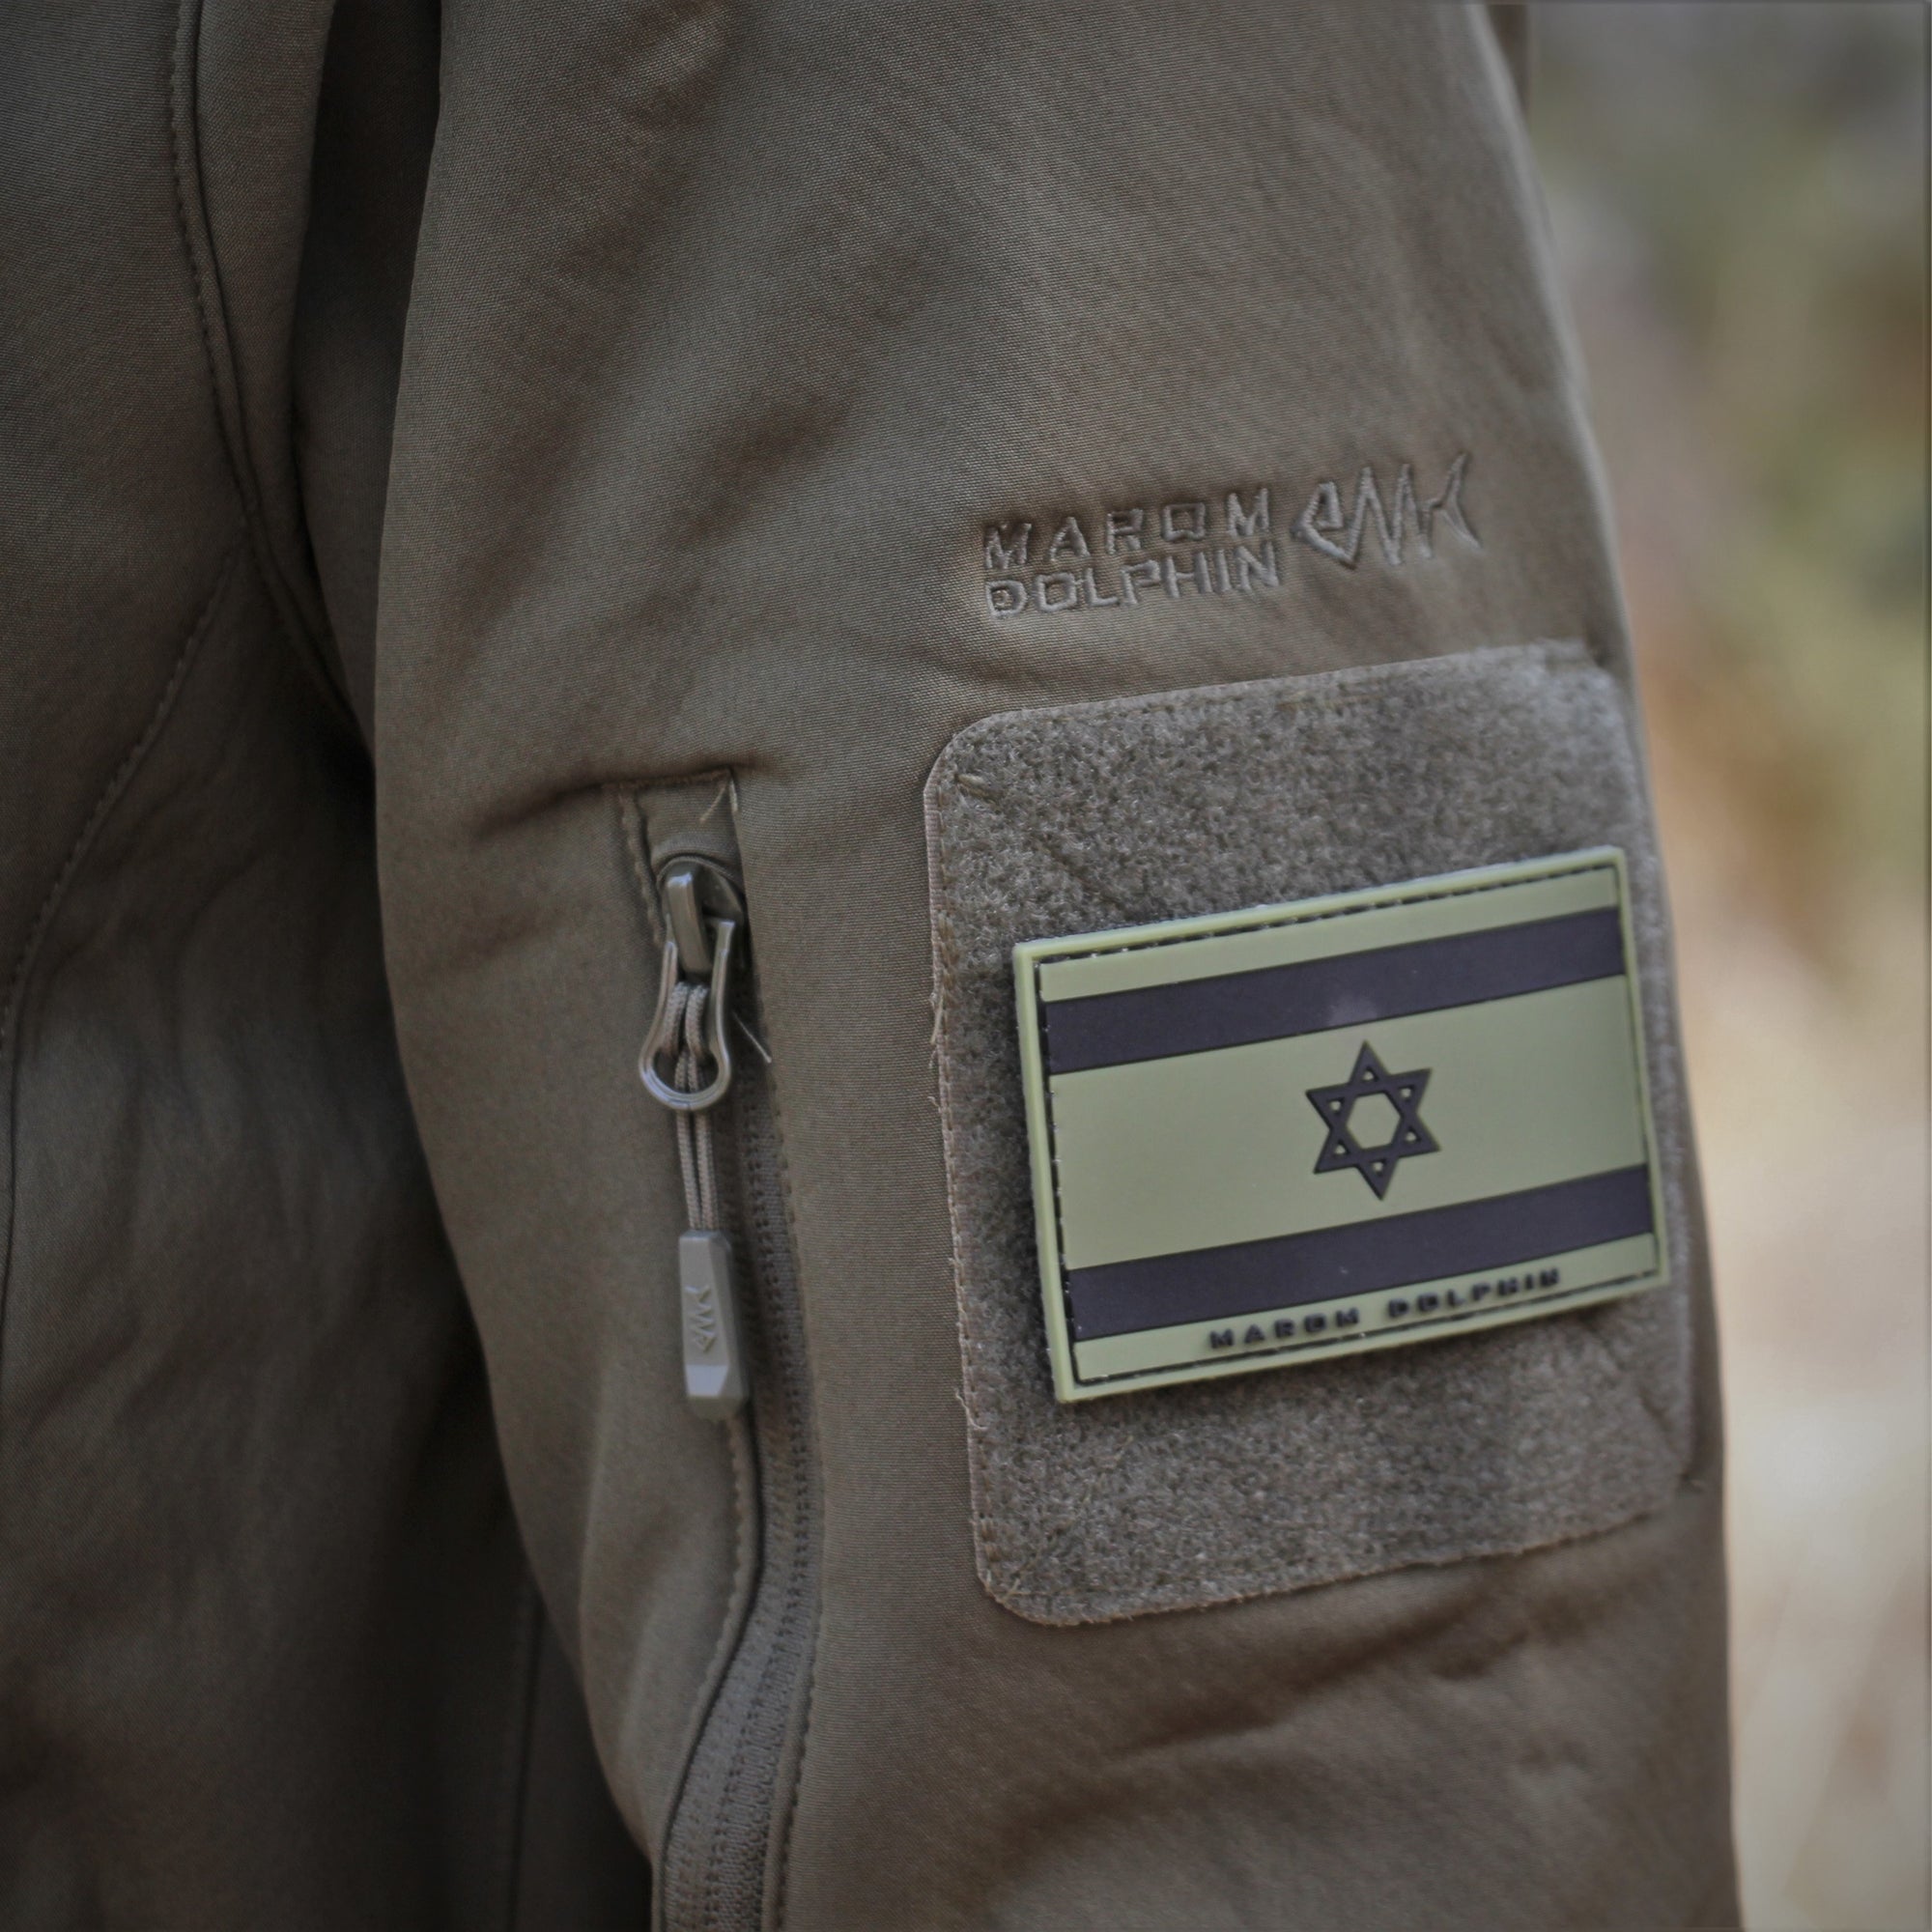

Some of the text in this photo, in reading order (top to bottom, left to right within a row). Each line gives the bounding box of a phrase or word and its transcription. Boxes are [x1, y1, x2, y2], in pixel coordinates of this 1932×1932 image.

[983, 487, 1270, 570] MAROM
[984, 540, 1280, 619] DOLPHIN
[1208, 1267, 1561, 1350] MAROM DOLPHIN
